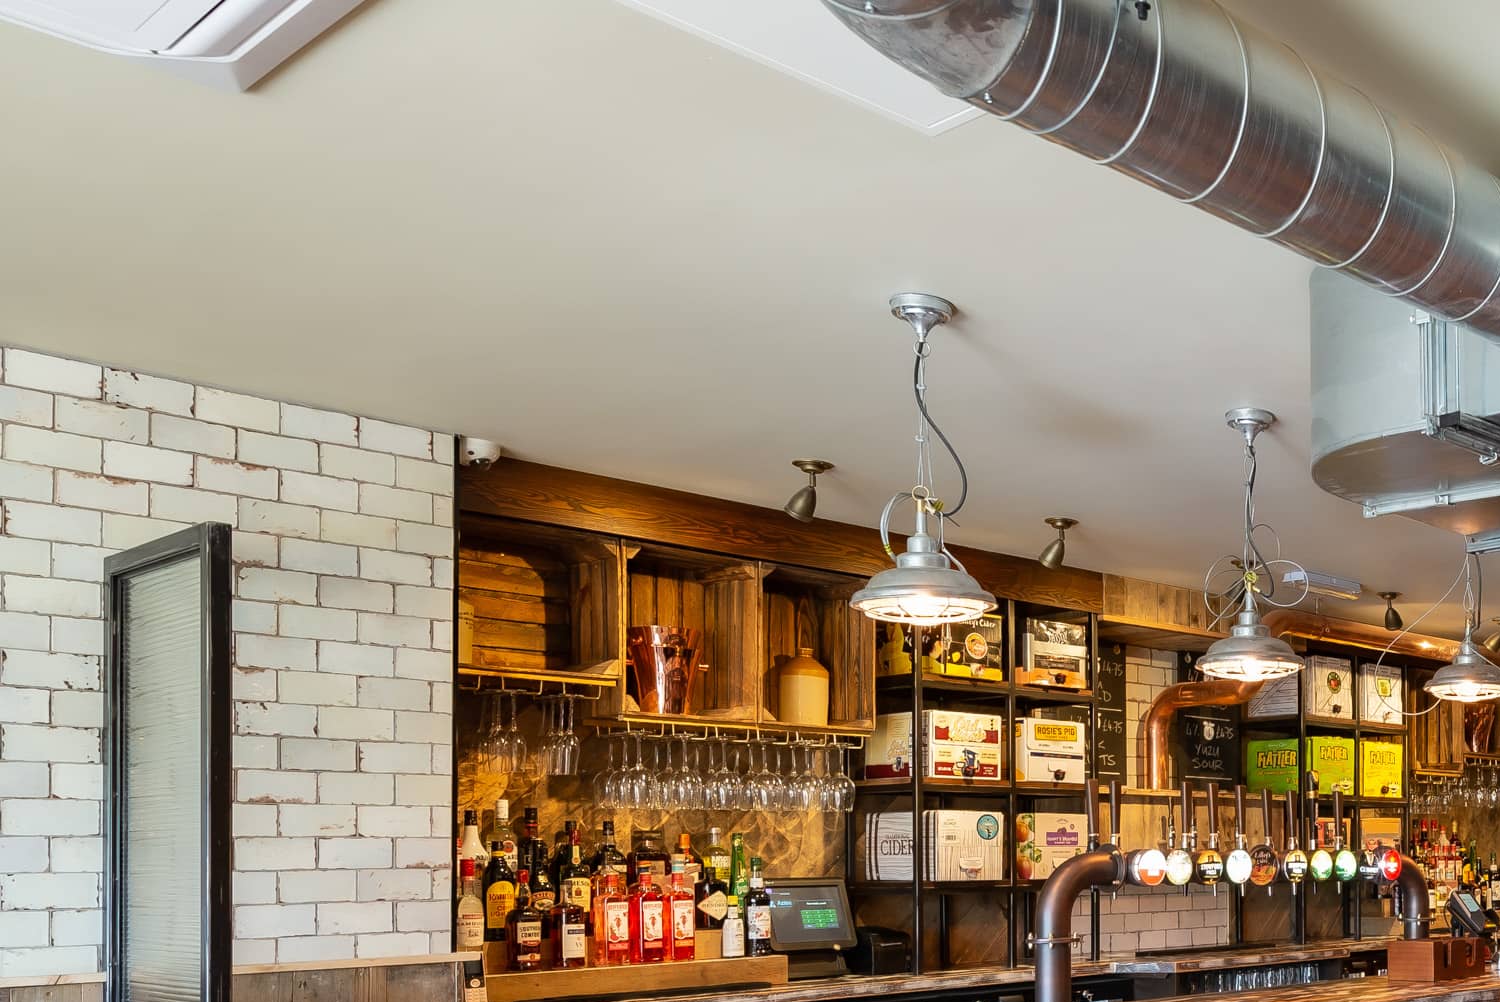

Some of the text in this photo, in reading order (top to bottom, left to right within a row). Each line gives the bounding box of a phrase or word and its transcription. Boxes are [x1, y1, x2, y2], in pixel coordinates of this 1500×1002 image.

[1037, 726, 1075, 736] ROSIE'S PIG
[1195, 743, 1219, 756] YUZU
[1192, 758, 1224, 771] SOUR
